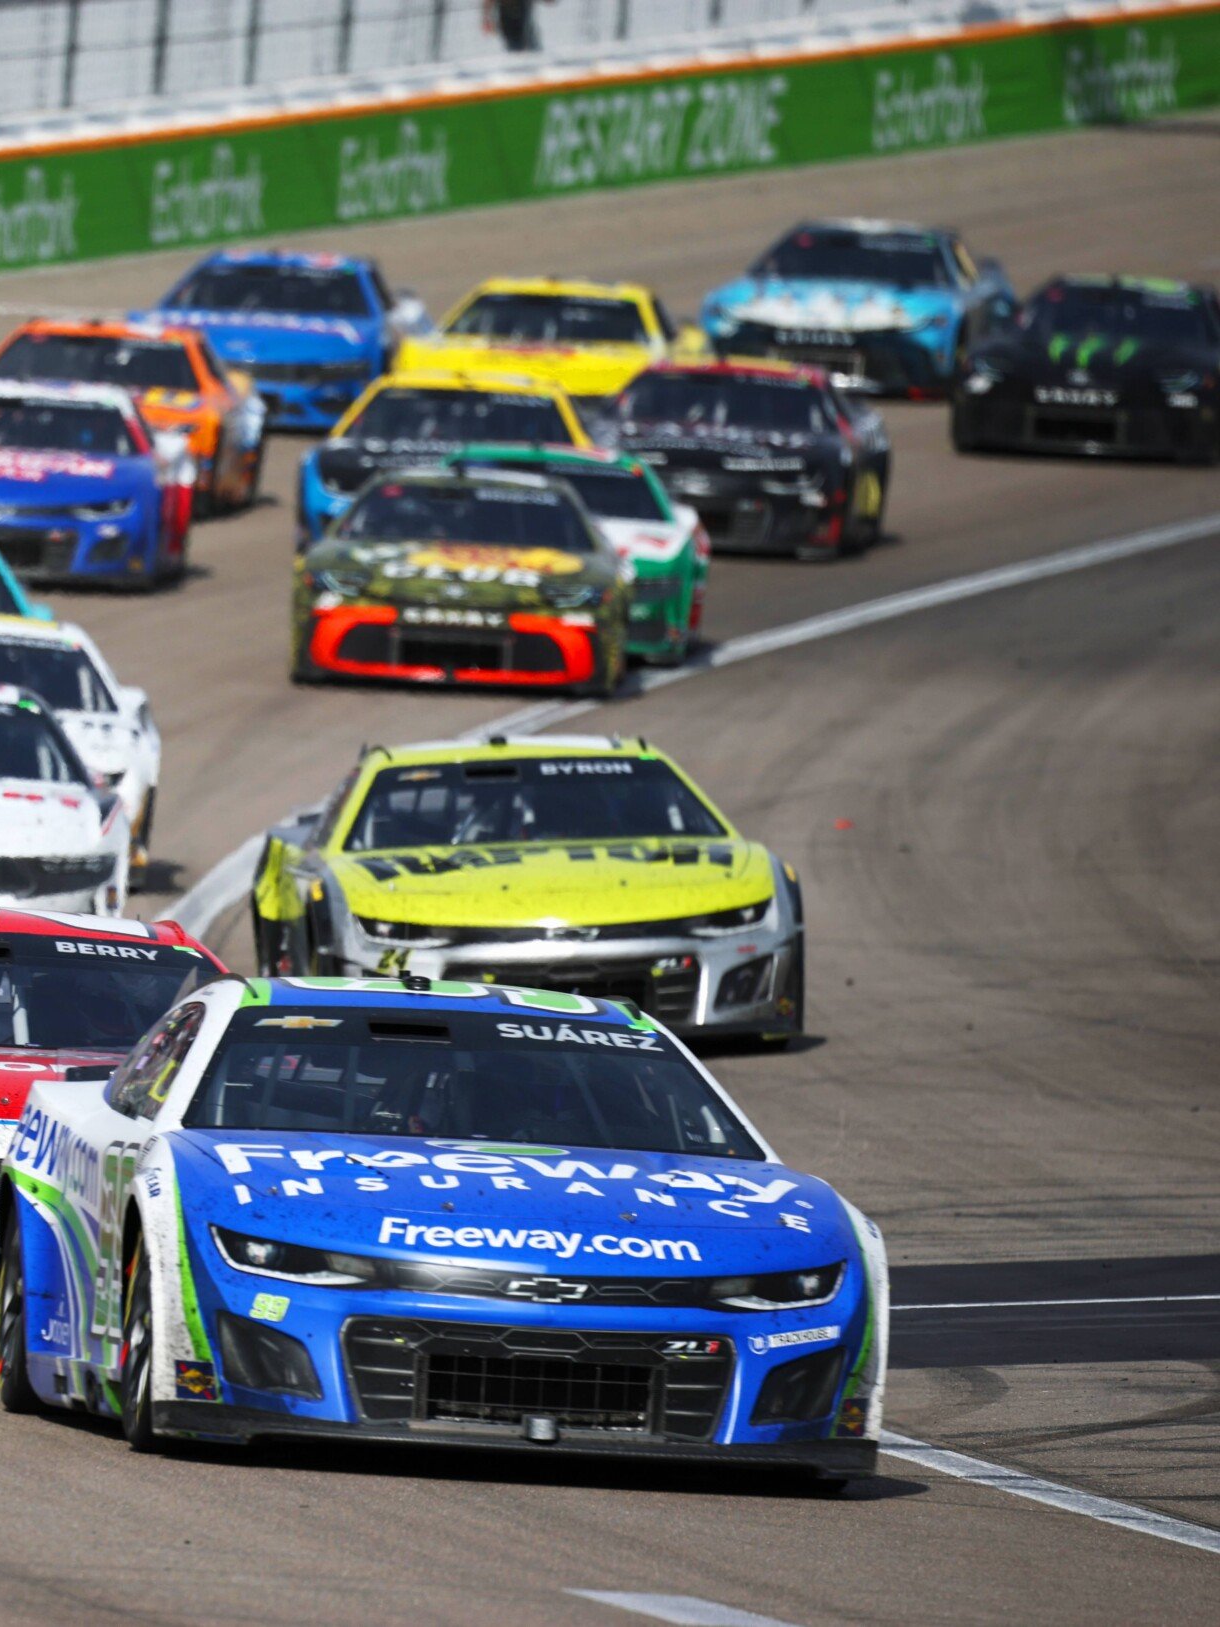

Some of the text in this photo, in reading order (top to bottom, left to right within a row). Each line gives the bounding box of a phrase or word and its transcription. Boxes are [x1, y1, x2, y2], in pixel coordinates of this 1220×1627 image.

[540, 761, 634, 777] BYRON
[55, 940, 160, 962] BERRY
[497, 1021, 666, 1053] SUÁREZ
[214, 1142, 799, 1204] Freeway
[239, 1174, 812, 1234] INSURANCE
[378, 1216, 702, 1262] Freeway.com
